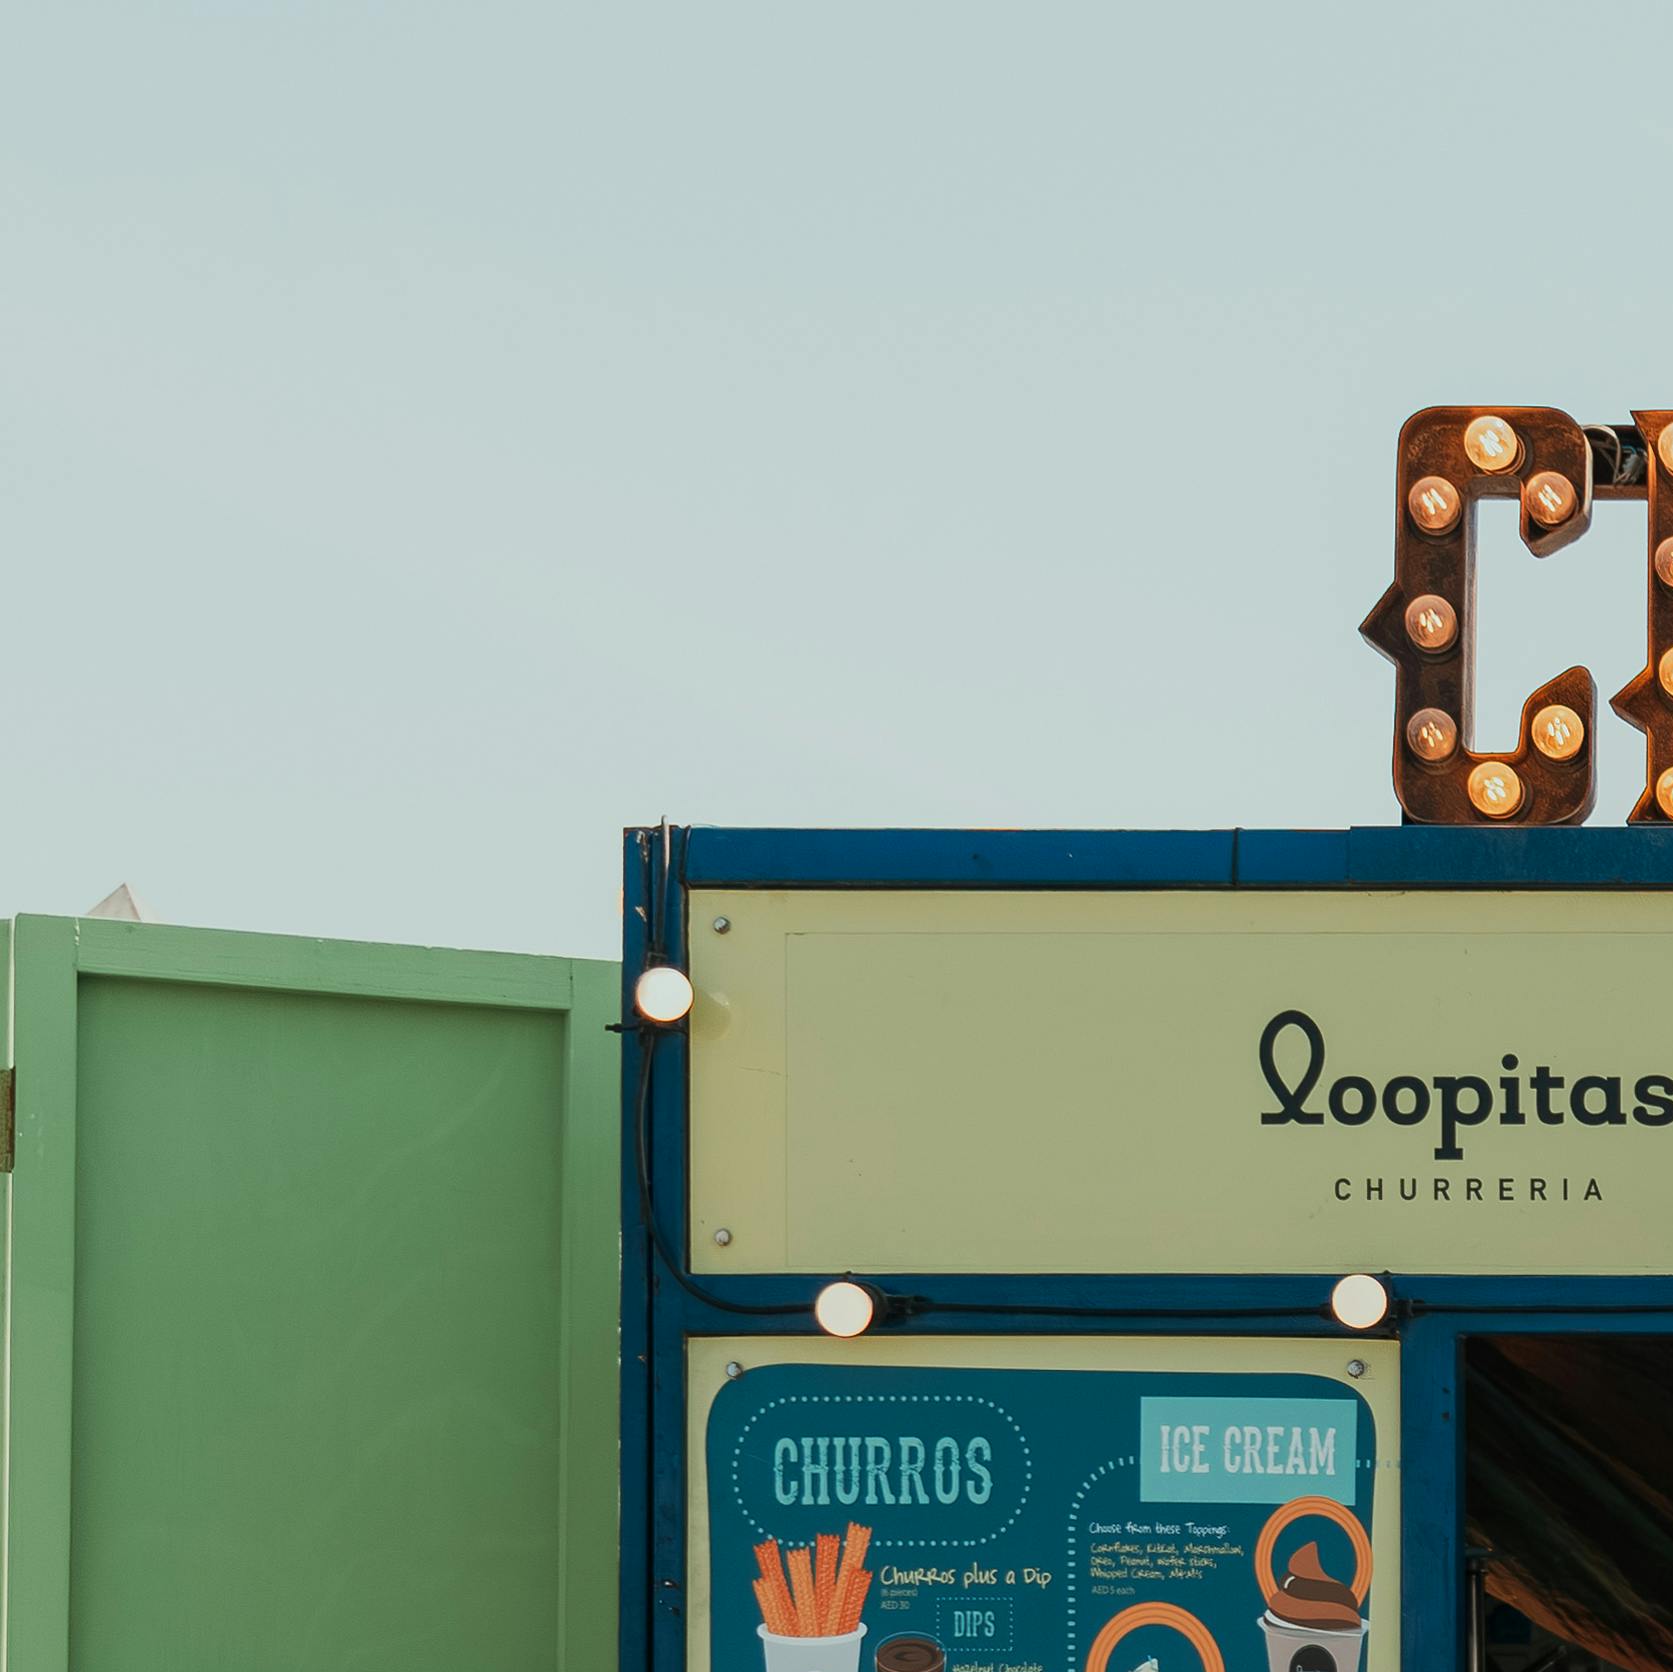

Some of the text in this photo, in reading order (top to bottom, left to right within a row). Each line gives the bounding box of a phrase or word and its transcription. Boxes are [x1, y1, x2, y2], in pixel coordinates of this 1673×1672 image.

[1335, 1179, 1602, 1200] CHURRERIA
[1160, 1426, 1335, 1475] ICE CREAM
[774, 1437, 993, 1505] CHURROS
[881, 1562, 1051, 1588] Churros plus a Dip
[954, 1611, 994, 1637] DIPS
